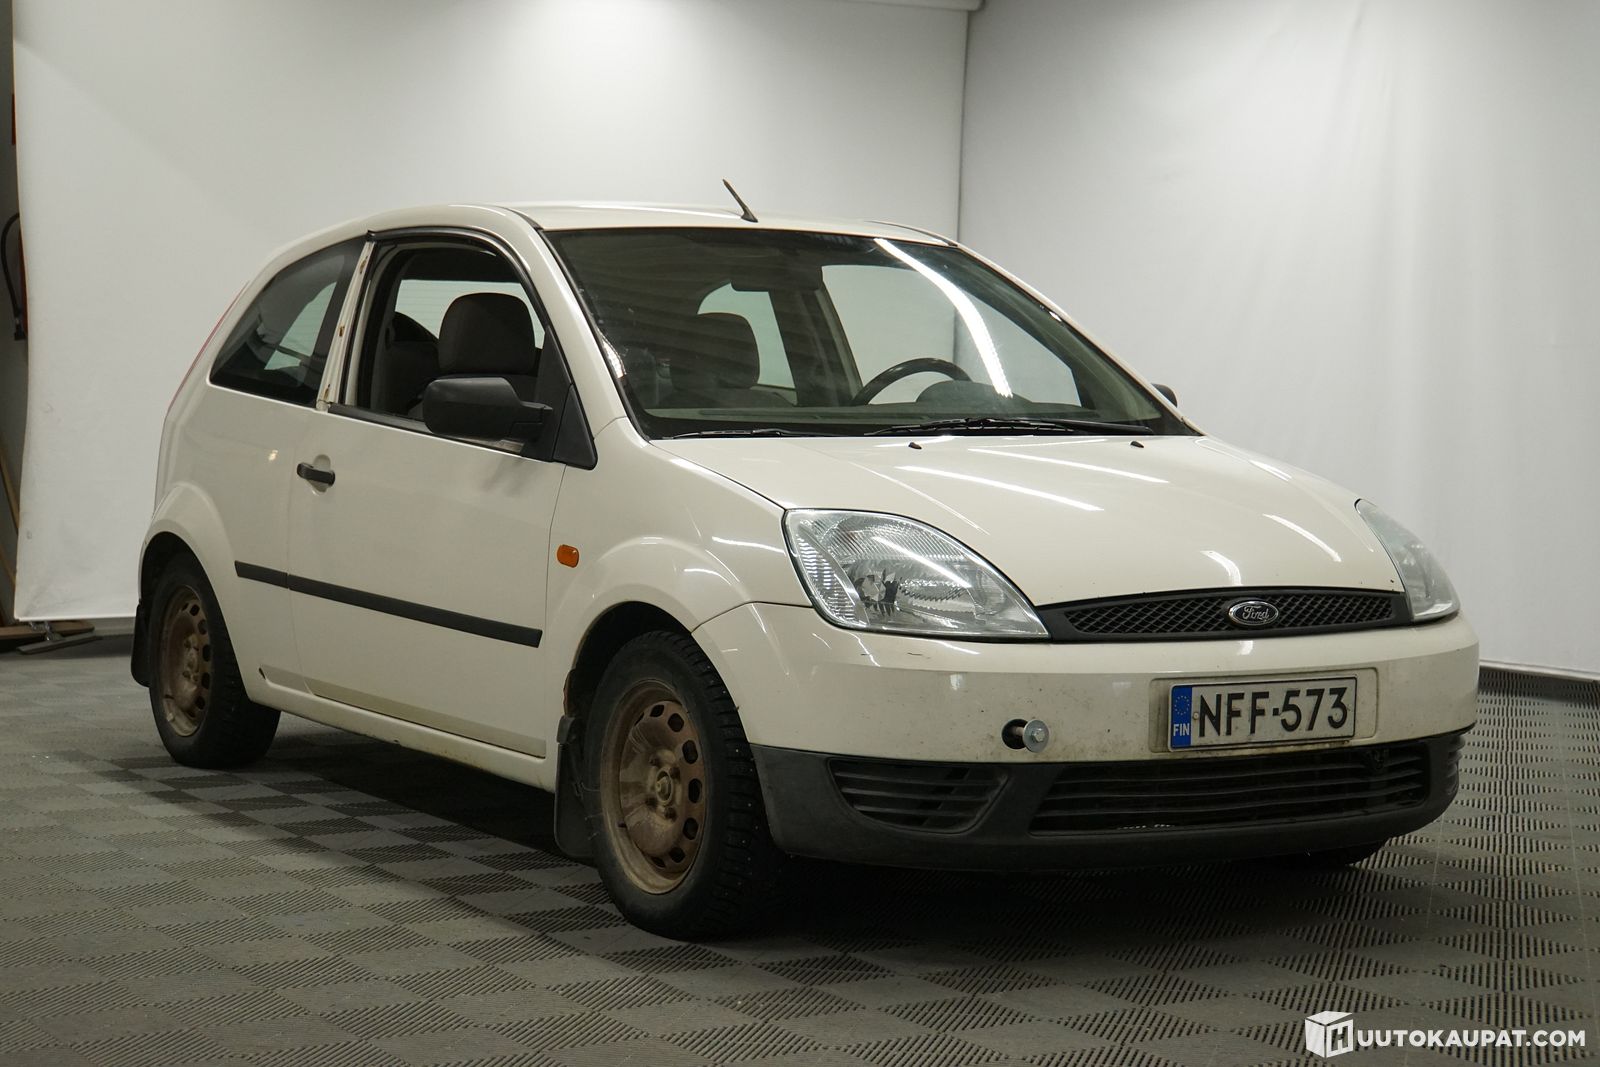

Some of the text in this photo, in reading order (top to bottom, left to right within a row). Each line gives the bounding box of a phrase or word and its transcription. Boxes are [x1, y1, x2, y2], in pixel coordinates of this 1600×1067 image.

[1242, 605, 1270, 620] Ford
[1199, 687, 1348, 737] NFF-573
[1173, 723, 1190, 736] FIN
